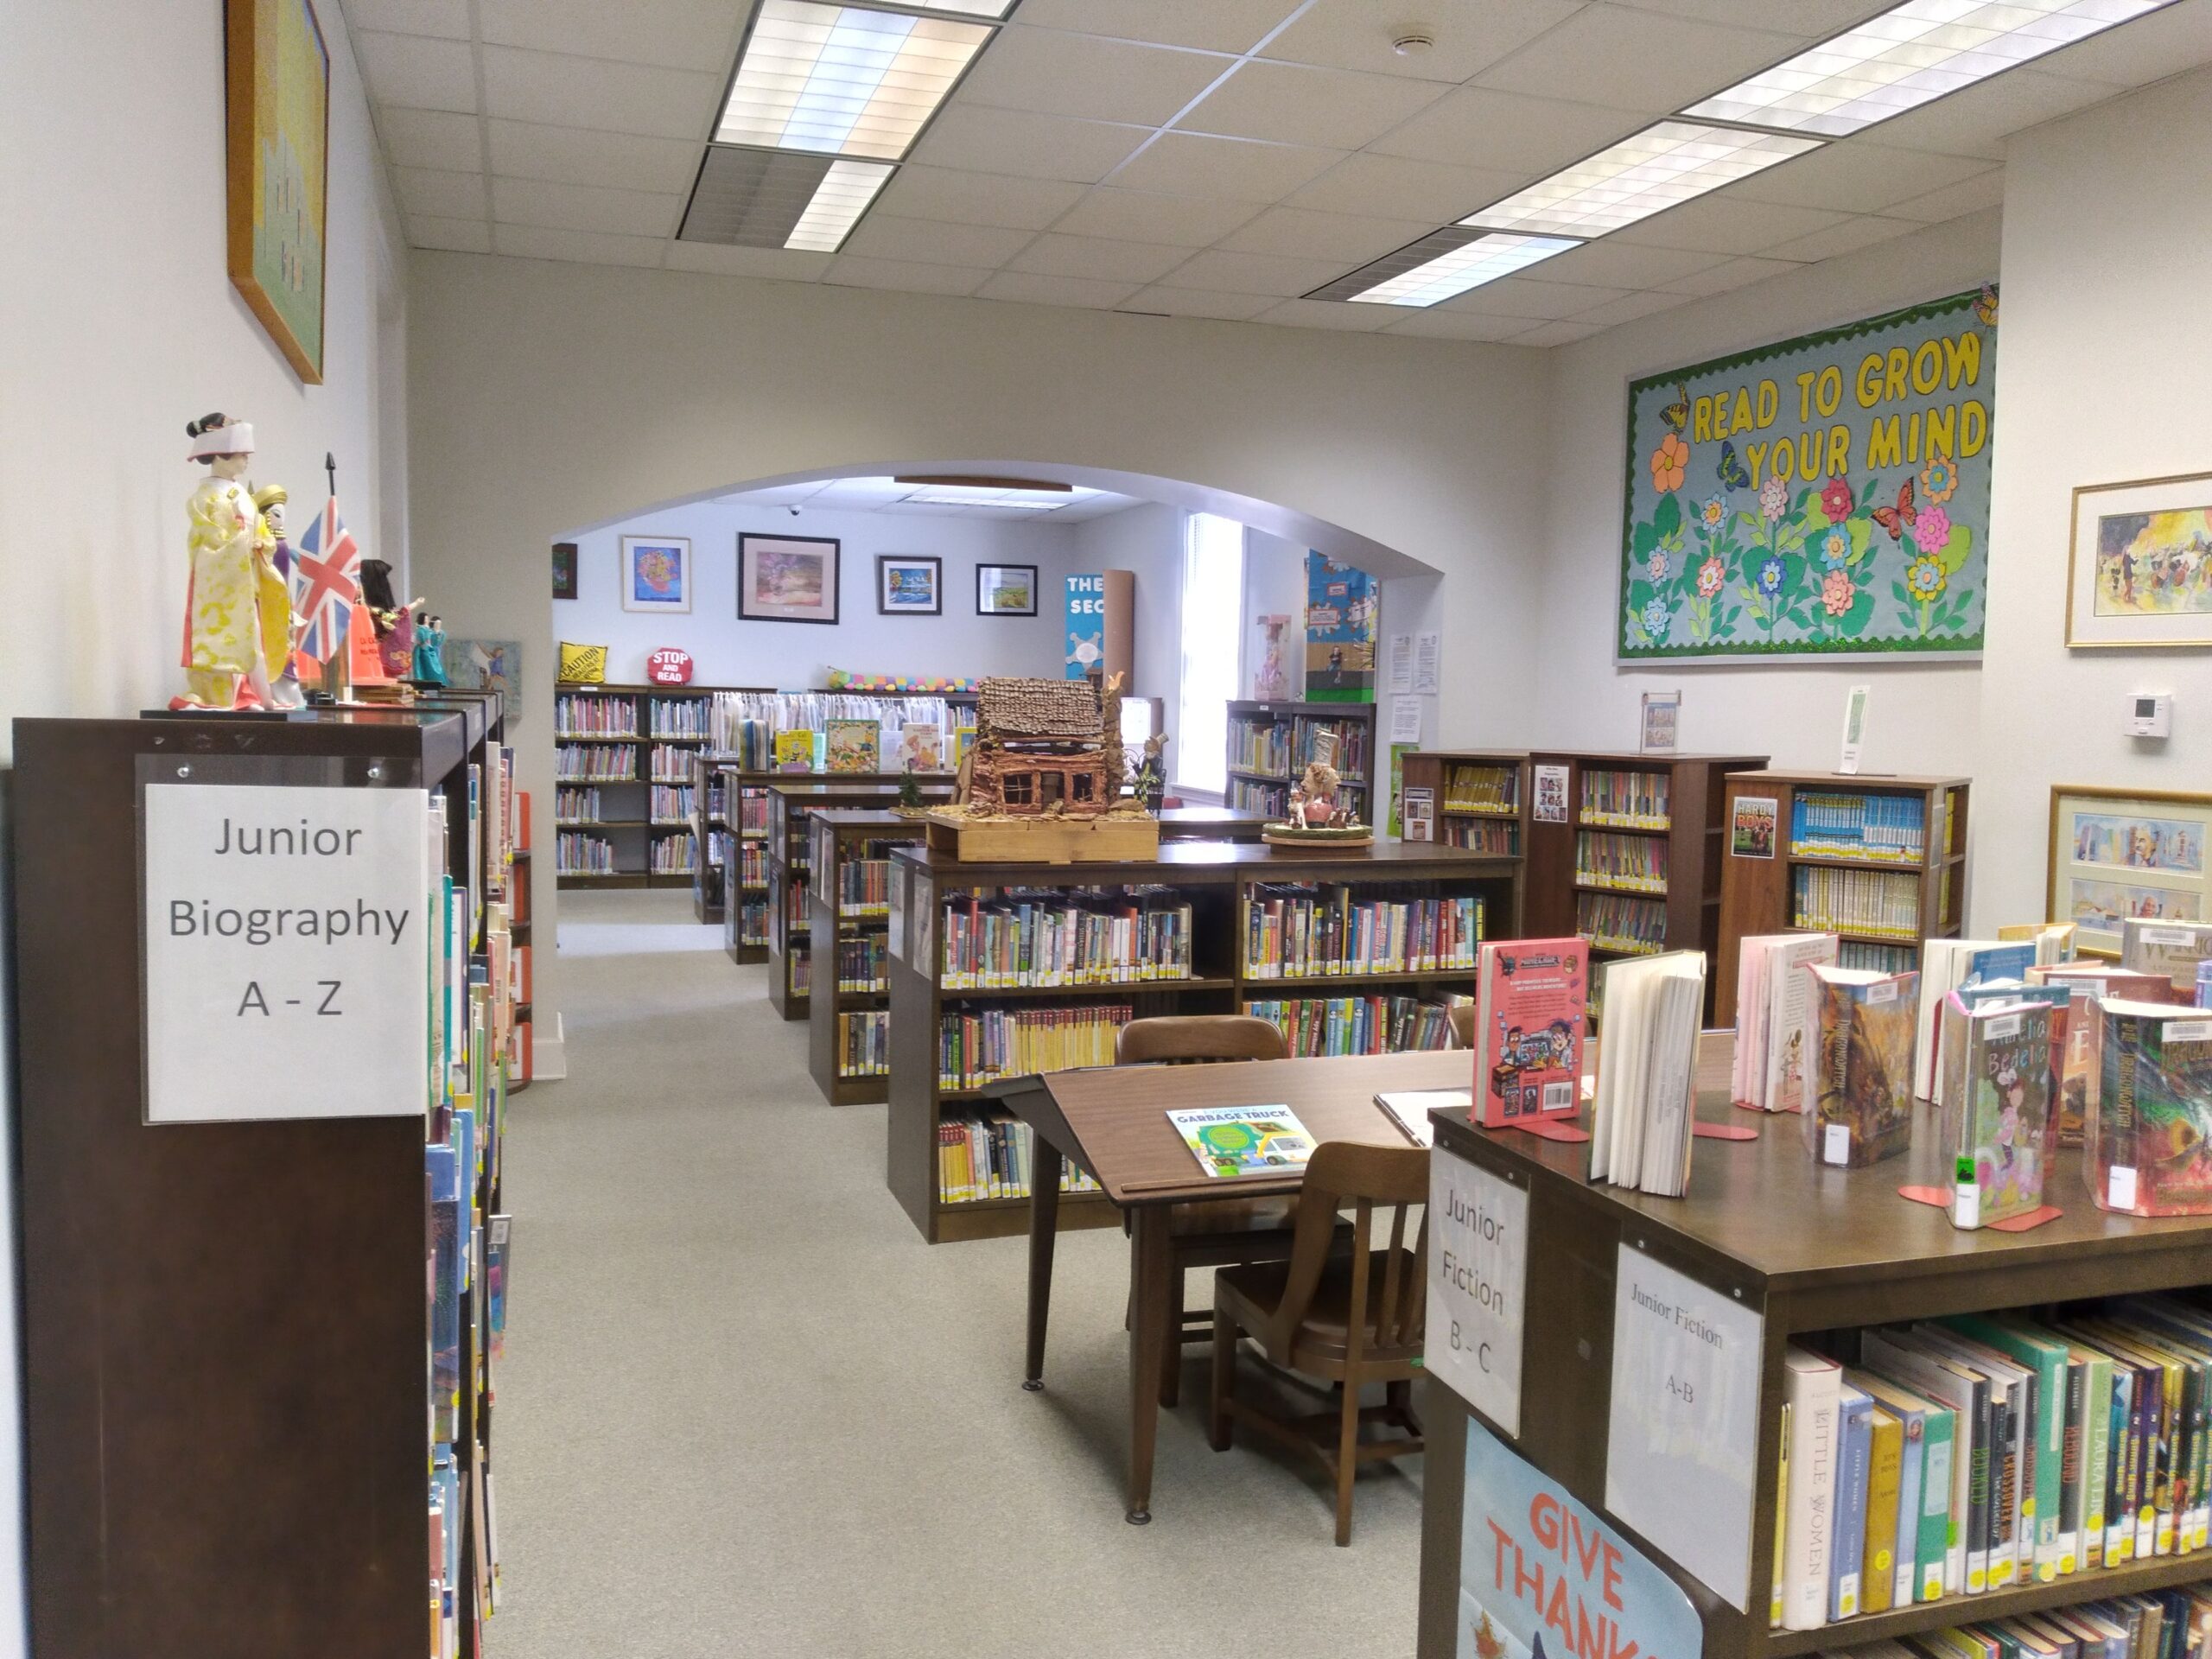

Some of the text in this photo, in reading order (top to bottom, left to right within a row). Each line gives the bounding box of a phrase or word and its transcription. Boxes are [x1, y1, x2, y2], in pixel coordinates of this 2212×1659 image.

[1694, 331, 1982, 443] READ TO GROW
[1745, 400, 1987, 492] YOUR MIND
[1067, 577, 1103, 592] THE
[1071, 599, 1104, 613] SEC
[563, 648, 600, 677] CAUTION
[653, 651, 689, 664] STOP
[657, 671, 682, 682] READ
[1737, 815, 1772, 830] BOYS
[1738, 804, 1773, 816] HARDY
[215, 817, 363, 855] Junior
[170, 899, 409, 945] Biography
[237, 981, 270, 1017] A
[317, 980, 342, 1015] Z
[1177, 1110, 1289, 1123] GARBAGE TRUCK
[1446, 1189, 1504, 1242] Junior
[1442, 1250, 1504, 1317] Fiction
[1630, 1282, 1724, 1351] Junior Fiction
[1451, 1321, 1461, 1351] B
[1479, 1343, 1491, 1374] C
[1666, 1374, 1694, 1404] A-B
[2133, 1415, 2140, 1425] 2
[2151, 1414, 2158, 1422] 3
[2194, 1413, 2202, 1421] 5
[1814, 1410, 1830, 1485] LITTLE
[2062, 1426, 2082, 1483] REBOUND
[1971, 1448, 1990, 1505] BOOKED
[2000, 1454, 2017, 1521] CROSSOVER
[2090, 1427, 2108, 1516] LAURA LIN
[1529, 1492, 1624, 1612] GIVE
[1808, 1495, 1826, 1576] WOMEN
[1487, 1515, 1660, 1659] THANK
